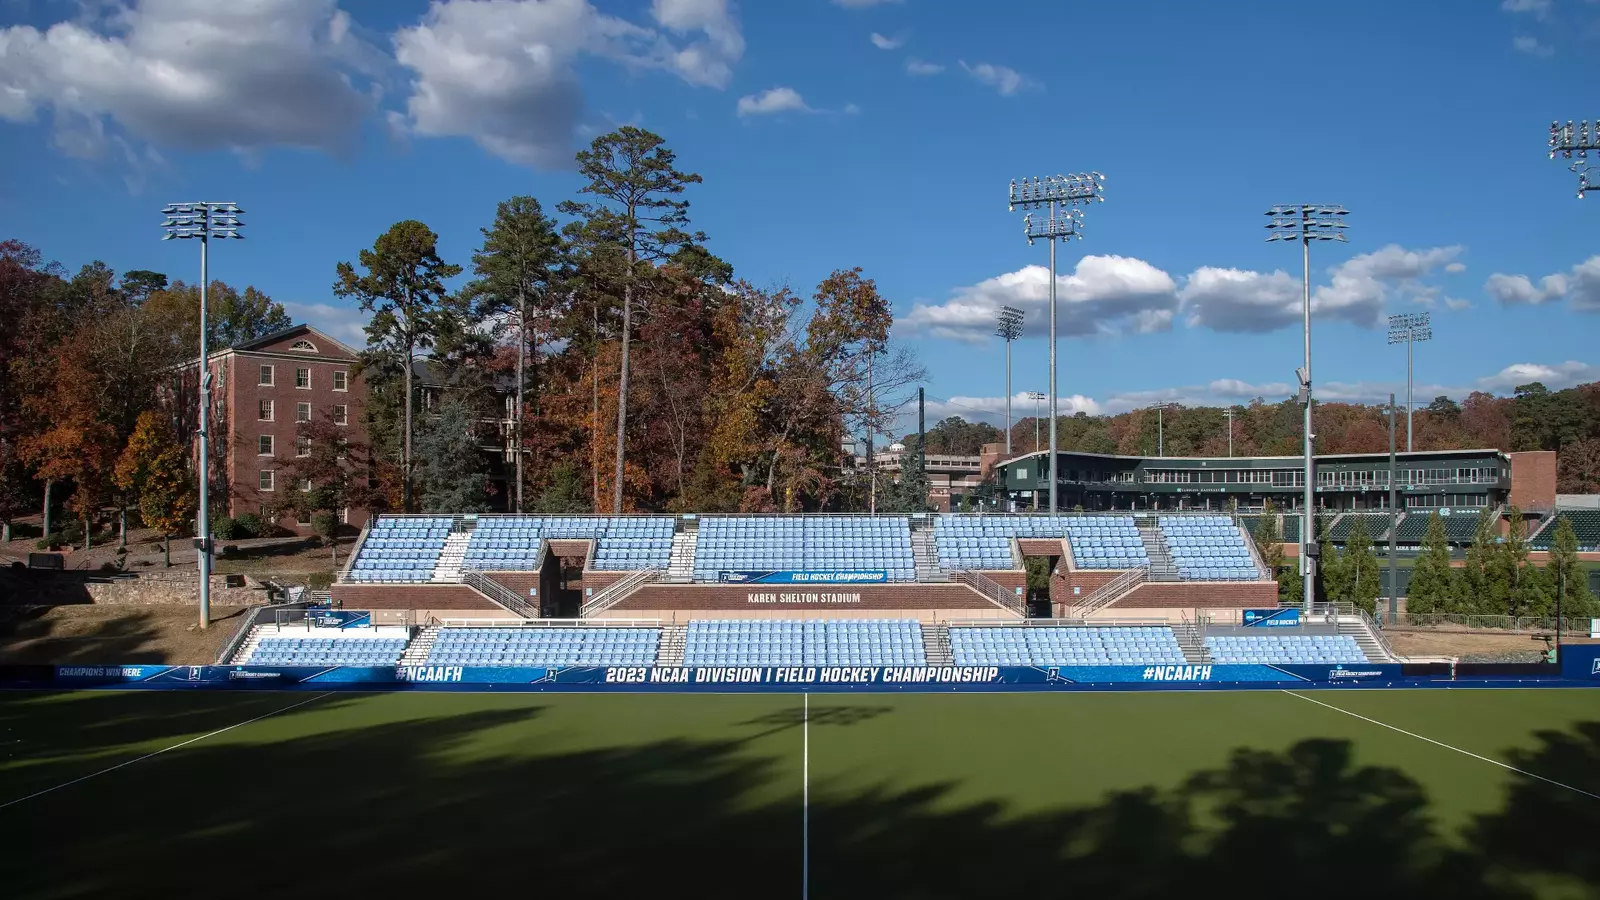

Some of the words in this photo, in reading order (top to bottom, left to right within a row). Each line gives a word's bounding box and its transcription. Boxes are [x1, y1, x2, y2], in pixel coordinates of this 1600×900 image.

[792, 573, 809, 581] FIELD
[810, 573, 835, 581] HOCKEY
[836, 573, 883, 581] CHAMPIONSHIP
[748, 593, 776, 603] KAREN
[779, 593, 818, 603] SHELTON
[820, 593, 860, 603] STADIUM
[59, 667, 104, 677] CHAMPIONS
[105, 667, 121, 677] WIN
[121, 667, 142, 677] HERE
[395, 666, 463, 682] #NCAAFH
[606, 667, 646, 683] 2023
[695, 667, 762, 683] DIVISION
[765, 667, 772, 683] I
[775, 667, 816, 682] FIELD
[820, 667, 879, 682] HOCKEY
[882, 667, 999, 682] CHAMPIONSHIP
[1143, 665, 1212, 681] #NCAAFH
